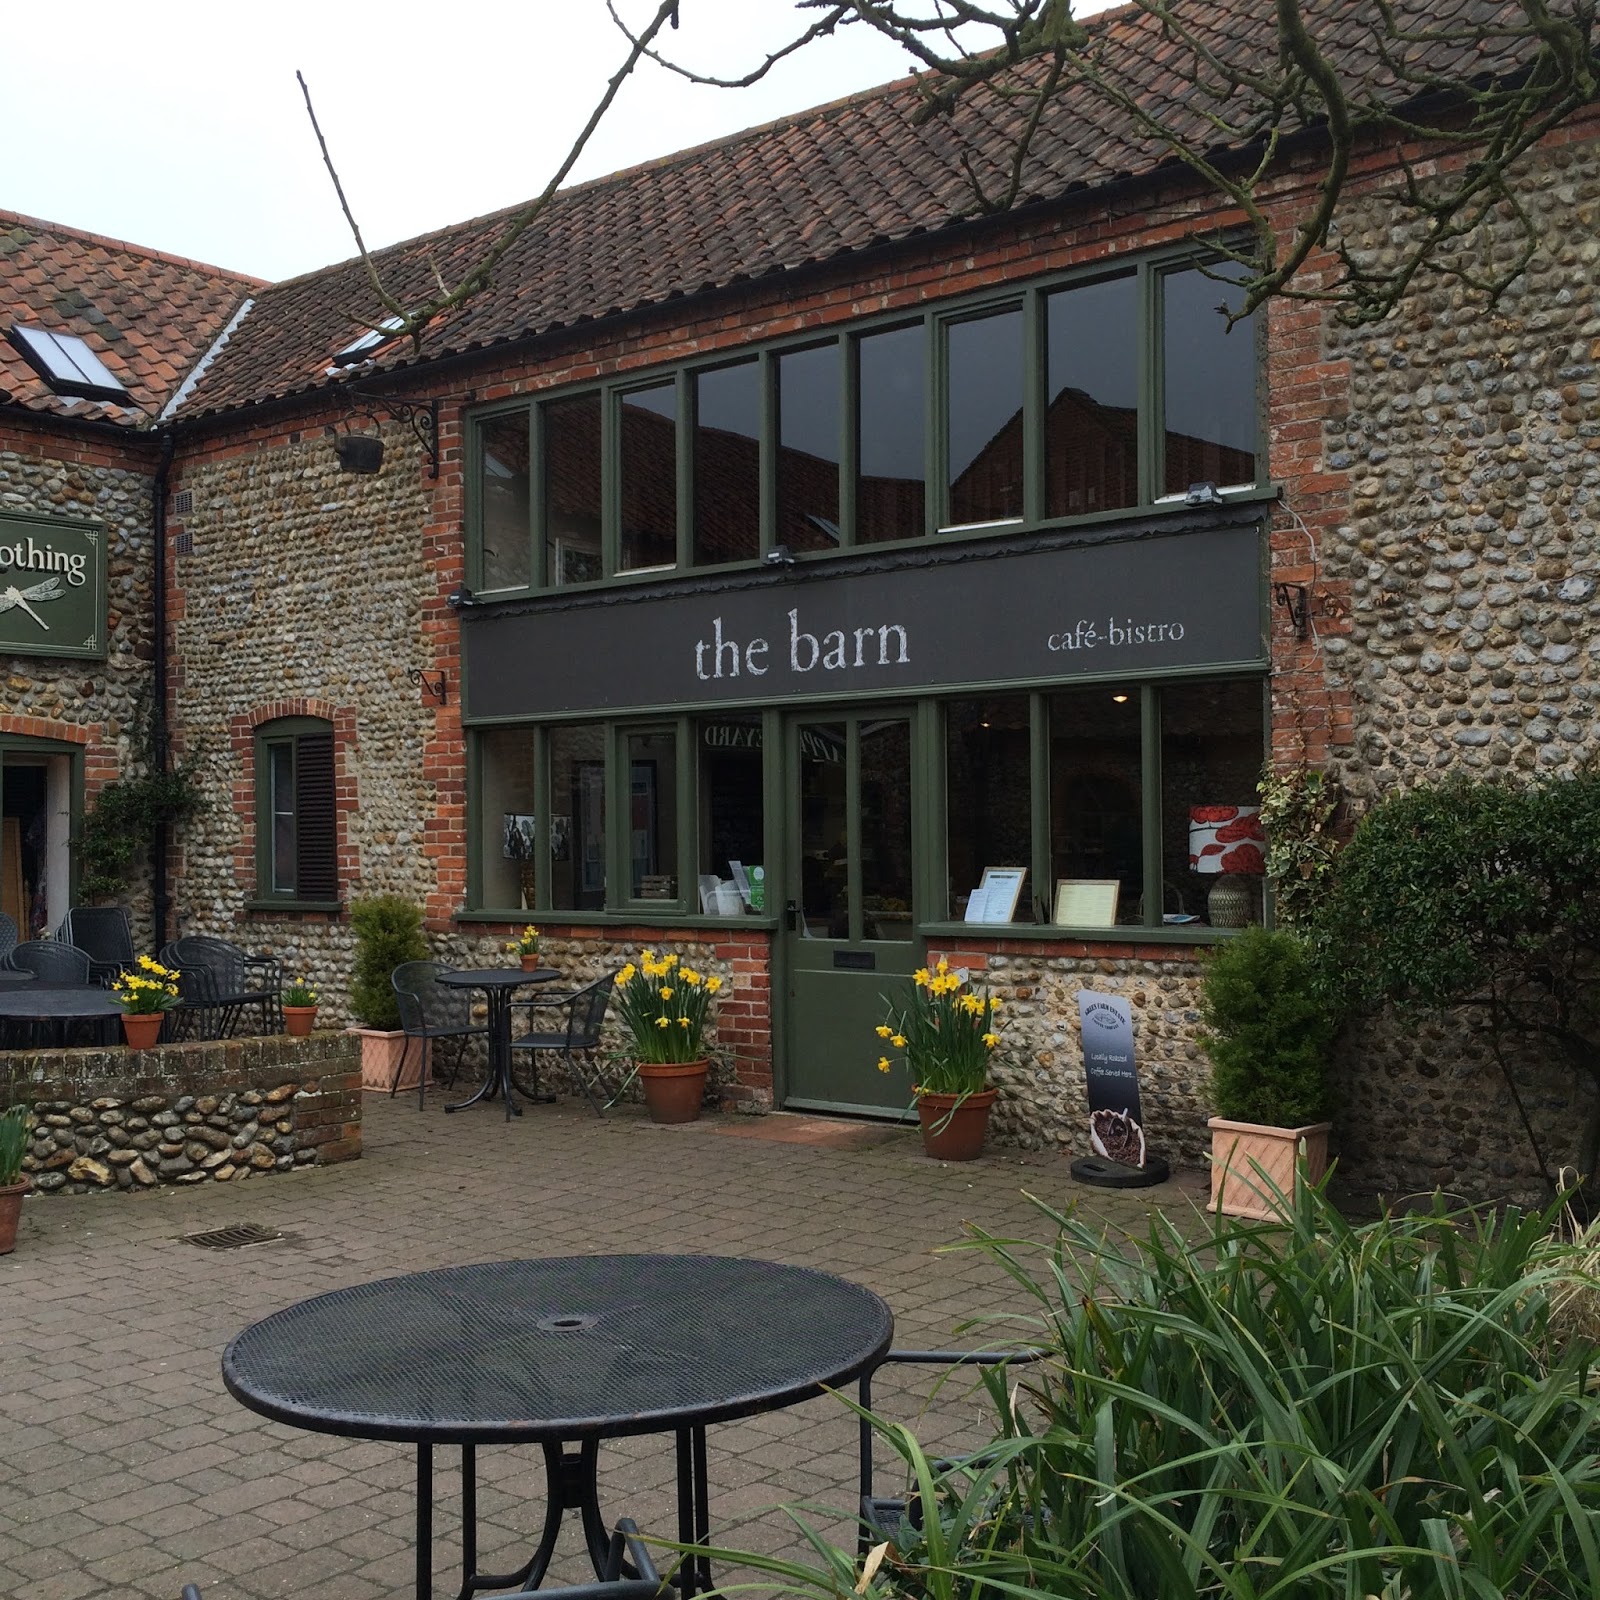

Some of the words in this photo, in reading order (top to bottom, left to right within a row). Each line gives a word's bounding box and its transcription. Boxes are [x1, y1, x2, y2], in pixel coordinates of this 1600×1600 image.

[0, 537, 86, 586] othing
[695, 616, 769, 680] the
[788, 608, 911, 672] barn
[1047, 616, 1185, 651] café-bistro
[1091, 1053, 1108, 1064] Locally
[1109, 1055, 1127, 1063] Roasted
[1091, 1067, 1104, 1077] Coffee
[1105, 1069, 1120, 1077] Served
